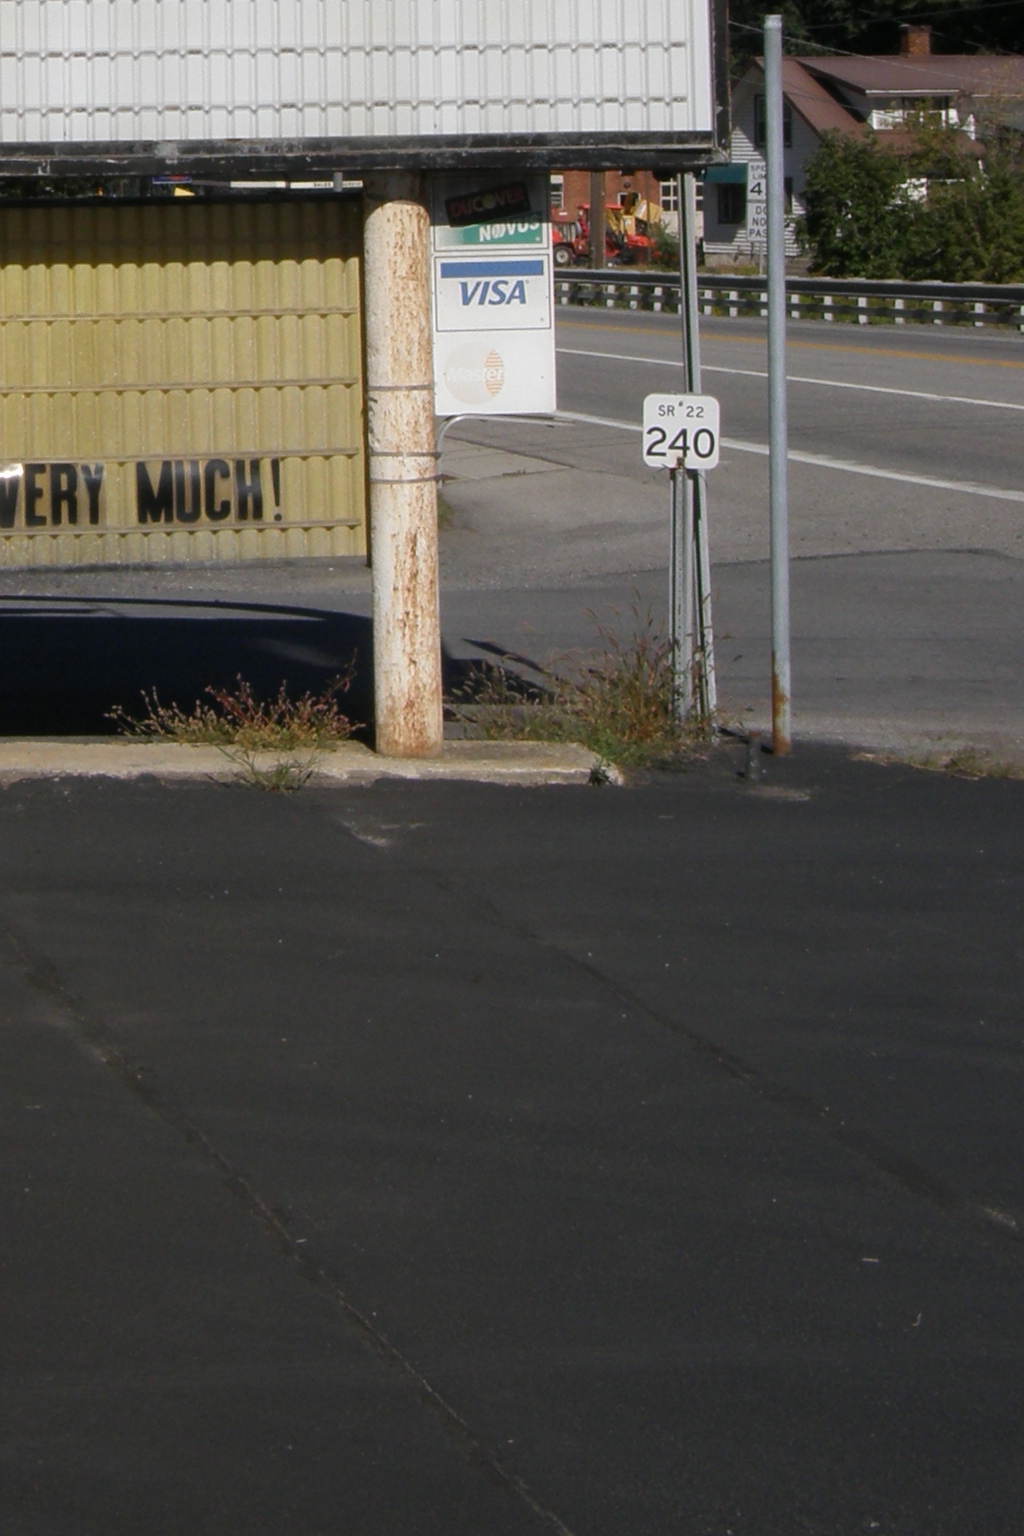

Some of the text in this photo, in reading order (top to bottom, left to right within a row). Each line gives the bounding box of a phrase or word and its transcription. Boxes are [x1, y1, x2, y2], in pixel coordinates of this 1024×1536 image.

[479, 214, 540, 243] NOVUS
[749, 229, 767, 237] PAS
[752, 217, 767, 226] NO
[459, 279, 527, 306] VISA
[658, 404, 704, 418] SR 22
[646, 426, 715, 459] 240
[136, 459, 282, 524] MUCH!
